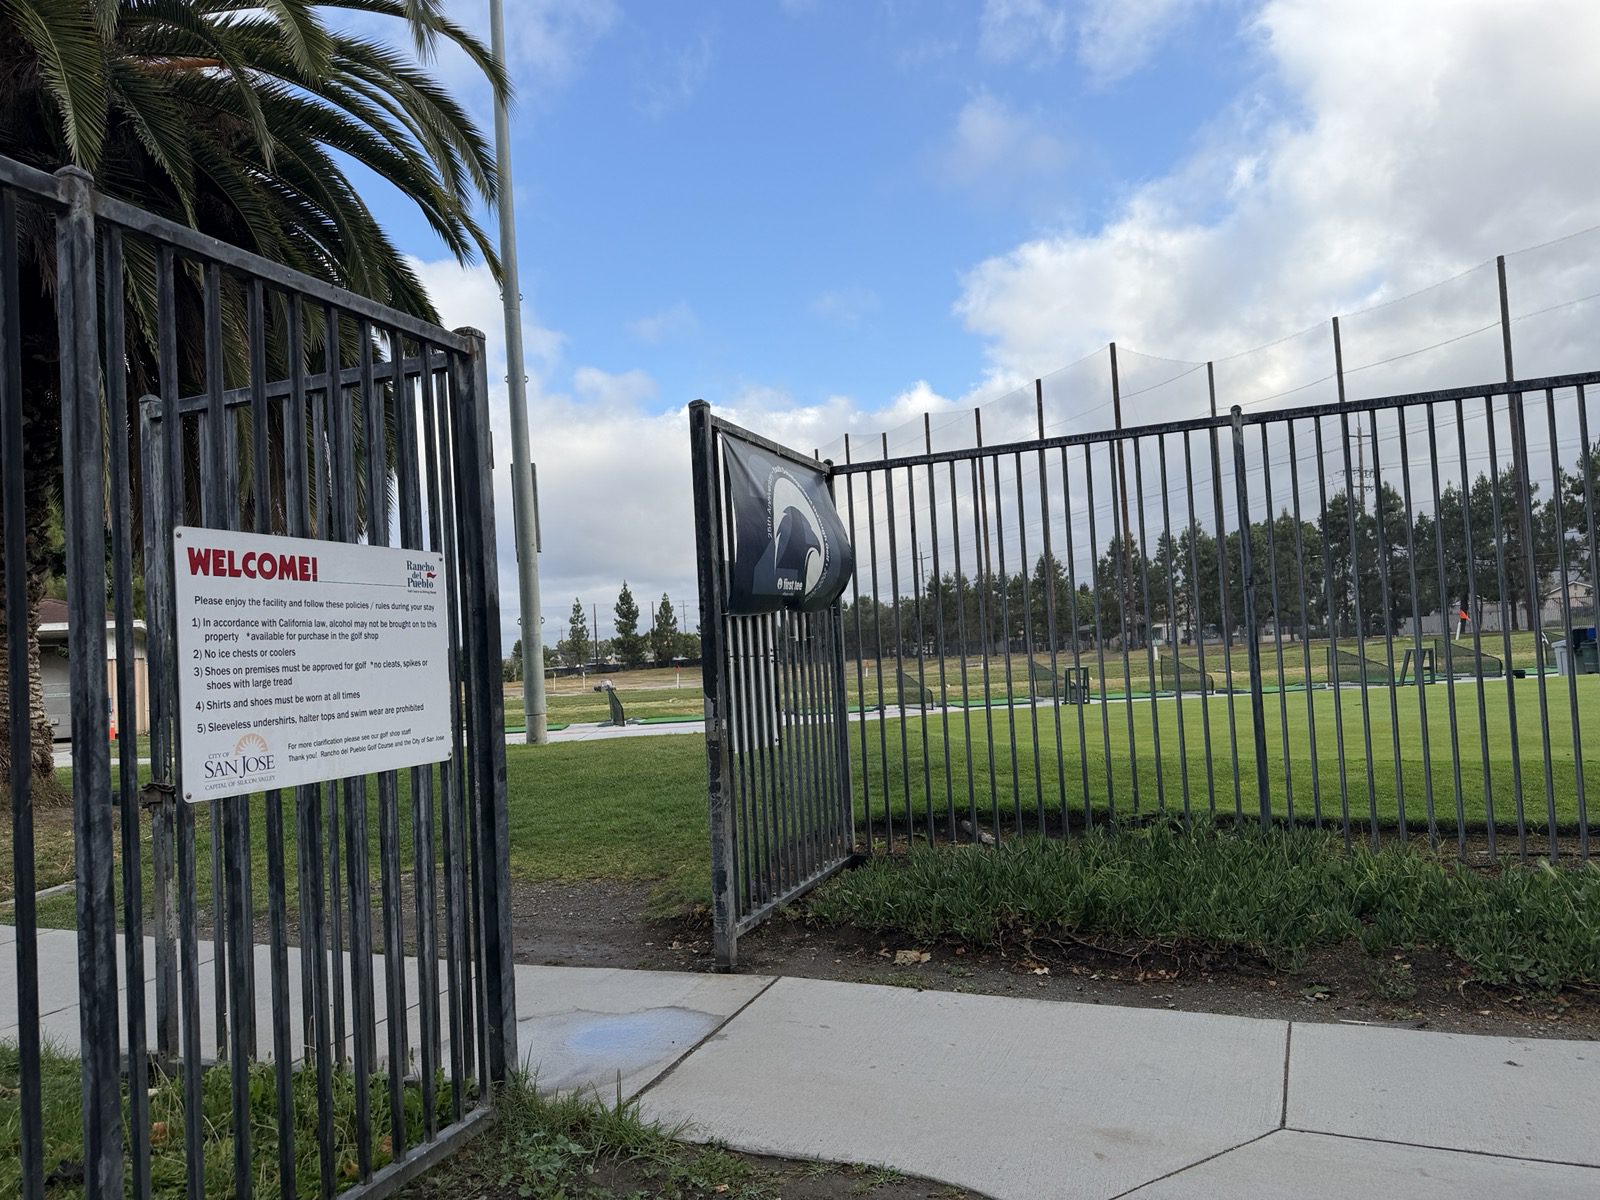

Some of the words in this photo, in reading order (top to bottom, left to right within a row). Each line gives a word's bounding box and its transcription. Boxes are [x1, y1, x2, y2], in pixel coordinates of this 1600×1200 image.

[186, 547, 318, 582] WELCOME!
[406, 560, 435, 571] Rancho
[412, 571, 422, 579] del
[407, 578, 434, 588] Pueblo
[783, 578, 794, 590] first
[794, 580, 802, 590] tee
[194, 596, 223, 605] Please
[225, 597, 246, 608] enjoy
[248, 598, 260, 606] the
[262, 598, 287, 608] facility
[304, 600, 324, 608] follow
[326, 600, 344, 608] these
[346, 602, 370, 610] policies
[370, 602, 374, 610] /
[391, 603, 410, 611] during
[424, 604, 434, 612] stay
[192, 618, 201, 628] 1)
[203, 618, 211, 627] In
[214, 618, 260, 627] accordance
[262, 618, 276, 627] with
[278, 618, 313, 628] California
[314, 619, 328, 628] law,
[330, 619, 352, 628] alcohol
[354, 621, 367, 630] may
[380, 620, 388, 628] be
[389, 620, 412, 630] brought
[204, 633, 239, 642] property
[286, 632, 296, 640] for
[298, 632, 329, 642] purchase
[331, 632, 337, 640] in
[338, 632, 350, 640] the
[350, 632, 362, 641] golf
[364, 632, 378, 640] shop
[193, 649, 202, 660] 2)
[204, 649, 216, 658] No
[218, 649, 230, 658] ice
[232, 648, 258, 658] chests
[270, 648, 296, 656] coolers
[194, 666, 202, 678] 3)
[204, 666, 230, 676] Shoes
[245, 665, 280, 676] premises
[282, 664, 300, 672] must
[302, 664, 310, 672] be
[312, 662, 342, 672] approved
[344, 662, 353, 670] for
[355, 661, 367, 671] golf
[383, 660, 402, 668] cleats,
[403, 660, 420, 668] spikes
[206, 680, 231, 690] shoes
[234, 679, 250, 688] with
[252, 678, 271, 689] large
[274, 677, 292, 686] tread
[196, 701, 204, 712] 4)
[206, 700, 231, 710] Shirts
[234, 698, 248, 708] and
[250, 698, 272, 706] shoes
[274, 696, 293, 704] must
[295, 694, 304, 703] be
[324, 693, 330, 701] at
[332, 692, 340, 700] all
[342, 691, 360, 699] times
[197, 723, 206, 734] 5)
[208, 721, 251, 732] Sleeveless
[253, 716, 297, 728] undershirts,
[299, 714, 319, 723] halter
[320, 712, 336, 722] tops
[337, 710, 349, 720] and
[350, 709, 368, 718] swim
[369, 708, 384, 716] wear
[396, 704, 424, 714] prohibited
[314, 737, 342, 747] clarification
[344, 736, 360, 744] please
[380, 731, 388, 740] golf
[288, 754, 305, 762] Thank
[204, 760, 238, 778] SAN
[239, 755, 276, 778] JOSE
[205, 782, 227, 790] CAPITAL
[258, 774, 276, 782] VALLEY
